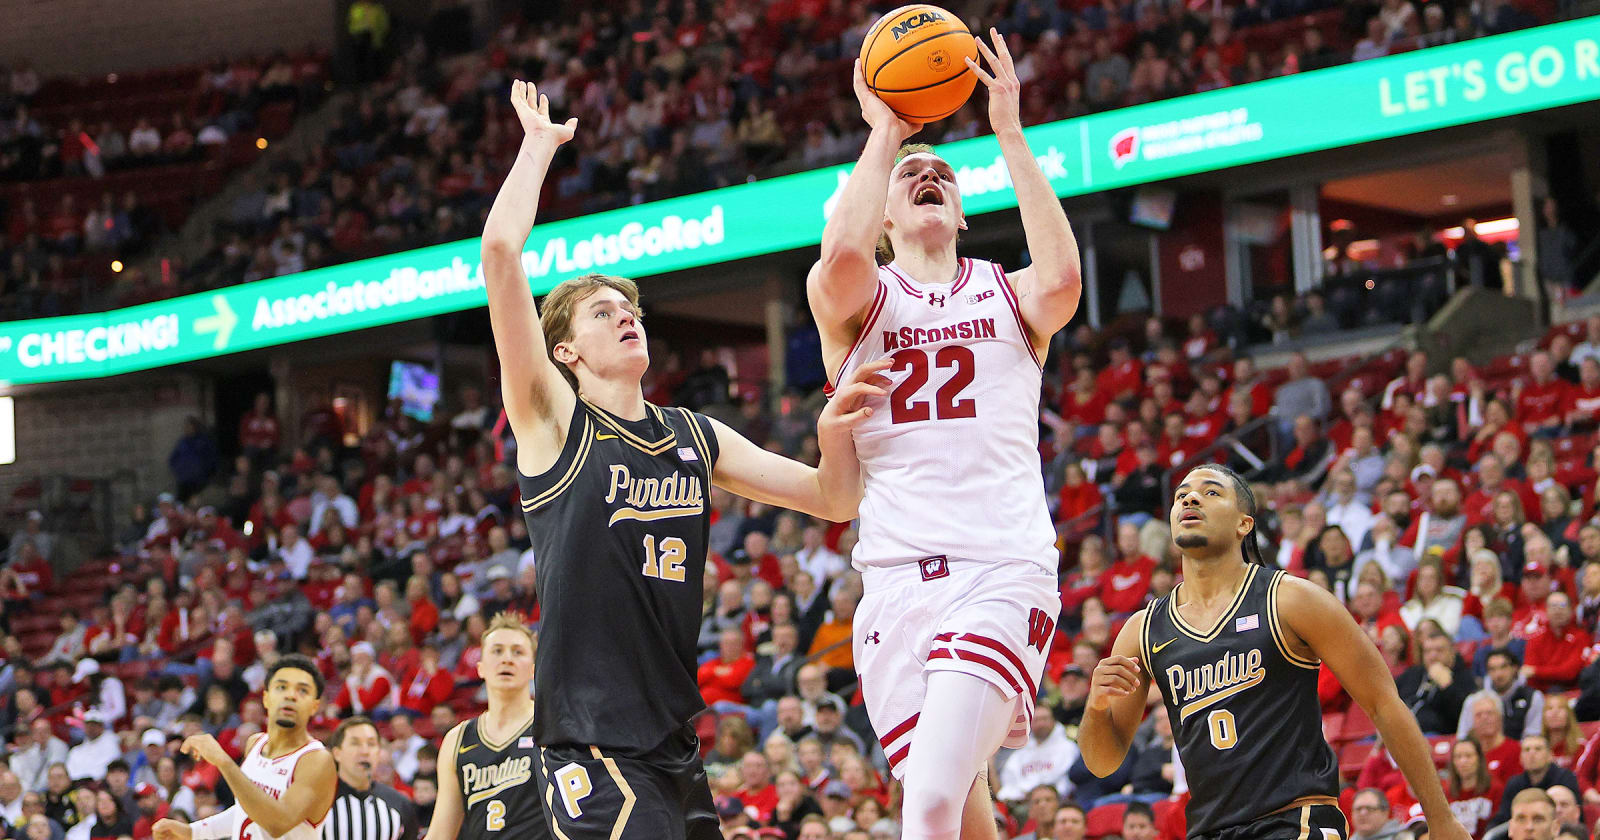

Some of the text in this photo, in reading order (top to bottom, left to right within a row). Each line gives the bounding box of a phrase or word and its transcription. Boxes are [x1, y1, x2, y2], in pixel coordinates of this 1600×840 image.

[891, 11, 945, 40] NCAA
[1379, 59, 1486, 117] LET'S
[1495, 45, 1565, 94] GO
[17, 313, 179, 368] CHECKING!
[889, 345, 976, 425] 22
[642, 534, 687, 582] 12
[1027, 607, 1055, 655] W
[1166, 648, 1264, 706] Purdue
[1207, 708, 1238, 750] 0
[462, 755, 532, 795] Purdue
[554, 761, 593, 820] P
[486, 799, 506, 831] 2
